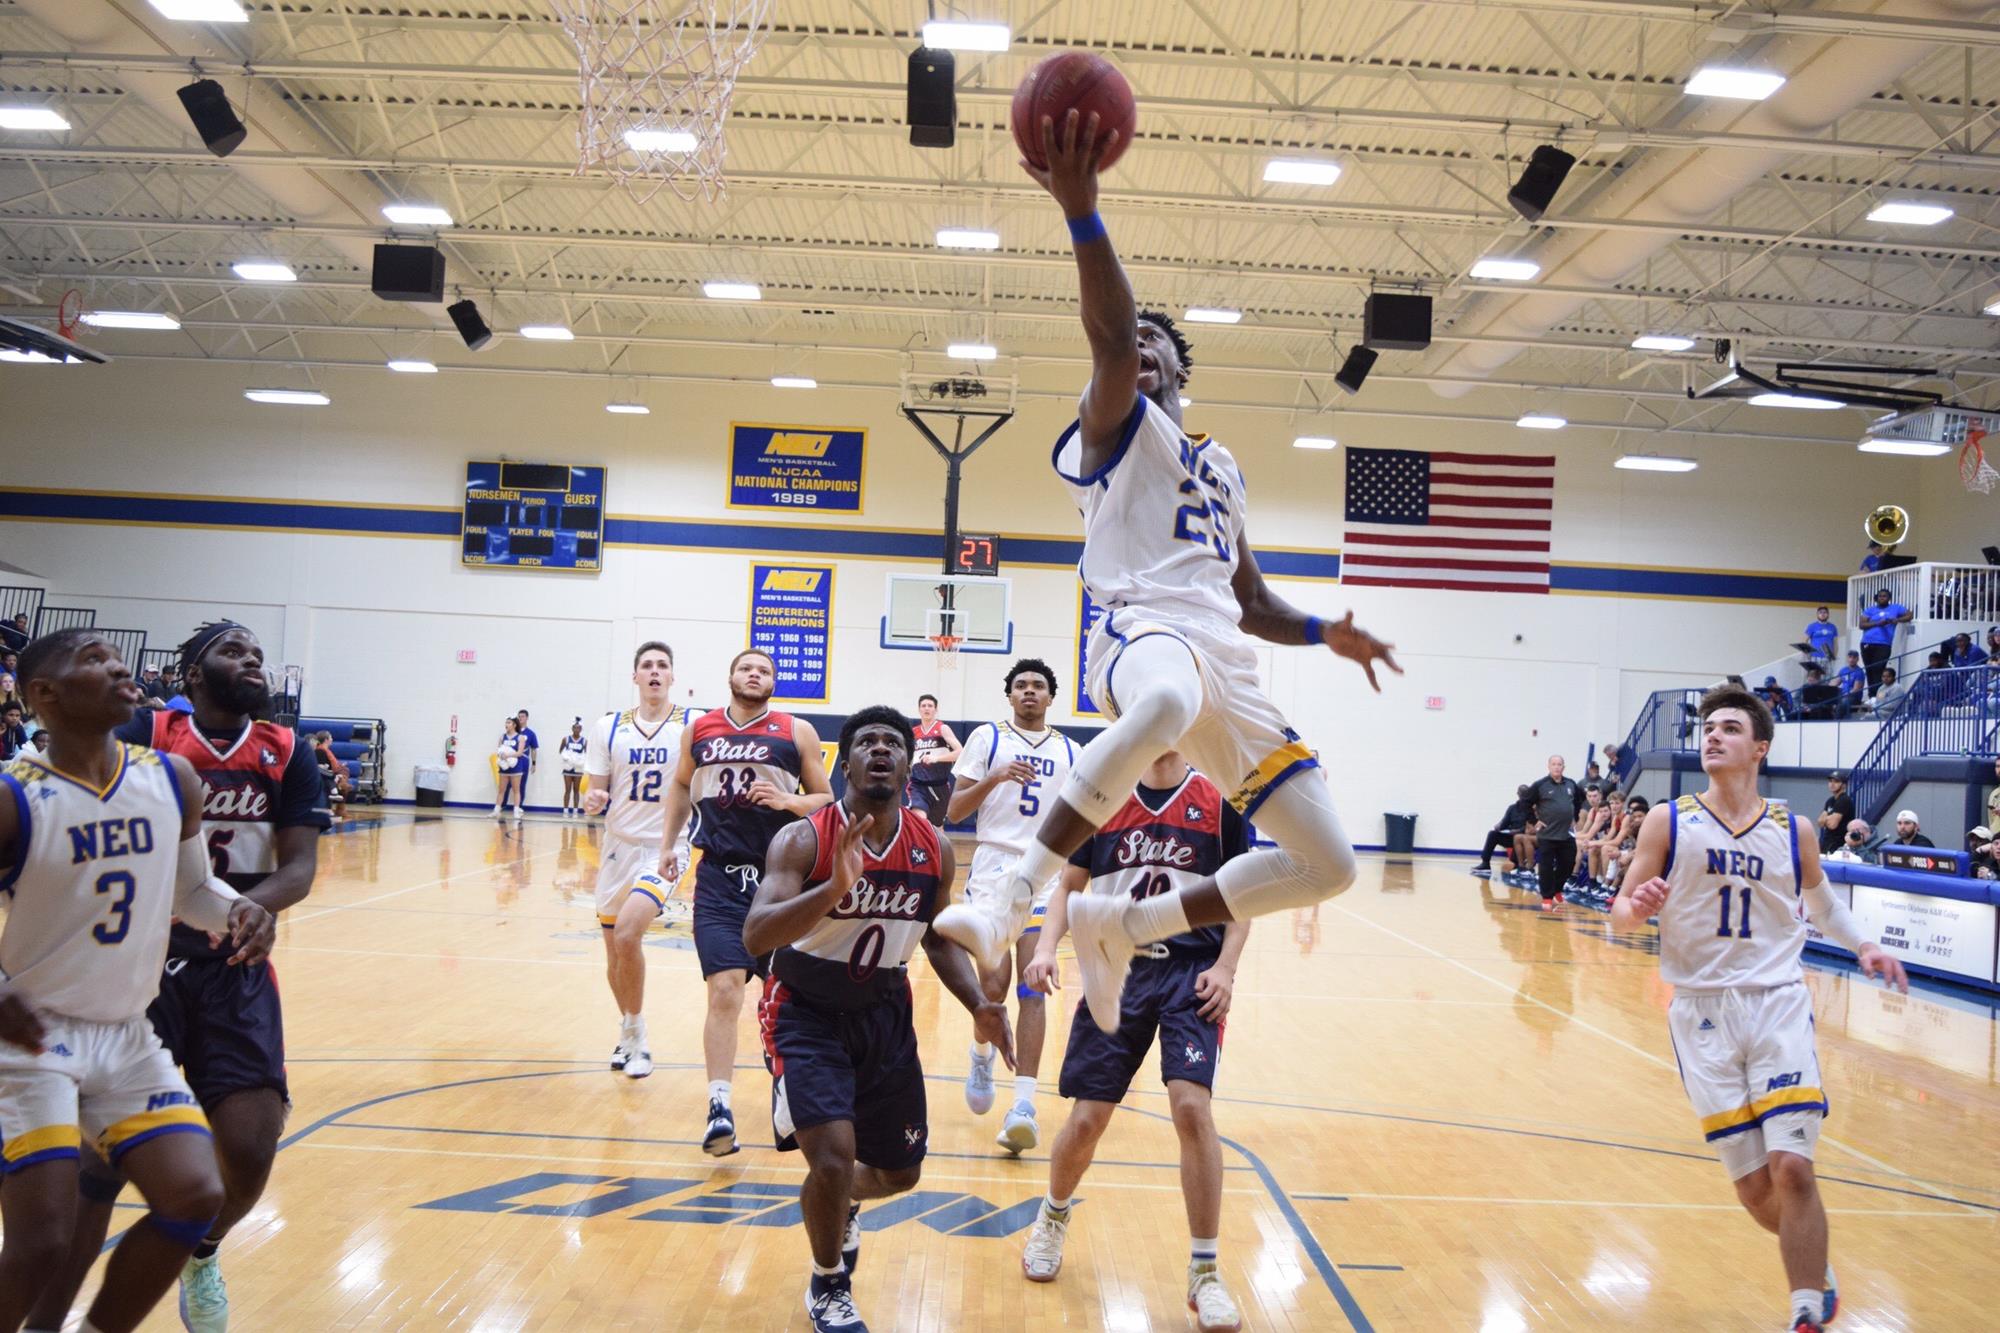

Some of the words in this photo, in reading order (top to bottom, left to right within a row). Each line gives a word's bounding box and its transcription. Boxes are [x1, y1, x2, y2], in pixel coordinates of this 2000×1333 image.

[764, 432, 833, 457] NEO
[771, 467, 821, 477] NJCAA
[735, 475, 788, 489] NATIONAL
[792, 478, 858, 492] CHAMPIONS
[522, 497, 547, 505] PERIOD
[564, 493, 597, 505] GUEST
[771, 493, 817, 505] 1989
[508, 528, 534, 536] PLAYER
[518, 557, 542, 565] MATCH
[960, 540, 992, 566] 27
[762, 570, 823, 592] NEO
[783, 595, 822, 603] BASKETBALL
[755, 616, 825, 628] CHAMPIONS
[756, 606, 825, 617] CONFERENCE
[756, 632, 775, 641] 1957
[803, 647, 823, 656] 1974
[802, 673, 822, 682] 2007
[629, 748, 668, 765] NEO
[702, 737, 769, 762] State
[629, 770, 662, 803] 12
[718, 767, 757, 809] 33
[201, 780, 268, 817] tate
[1019, 782, 1042, 817] 5
[67, 817, 154, 864] NEO
[1117, 830, 1193, 866] State
[1705, 848, 1764, 881] NEO
[835, 877, 921, 915] State
[92, 870, 136, 945] 3
[1716, 885, 1752, 939] 11
[848, 924, 886, 983] 0
[1766, 1071, 1802, 1092] NEO
